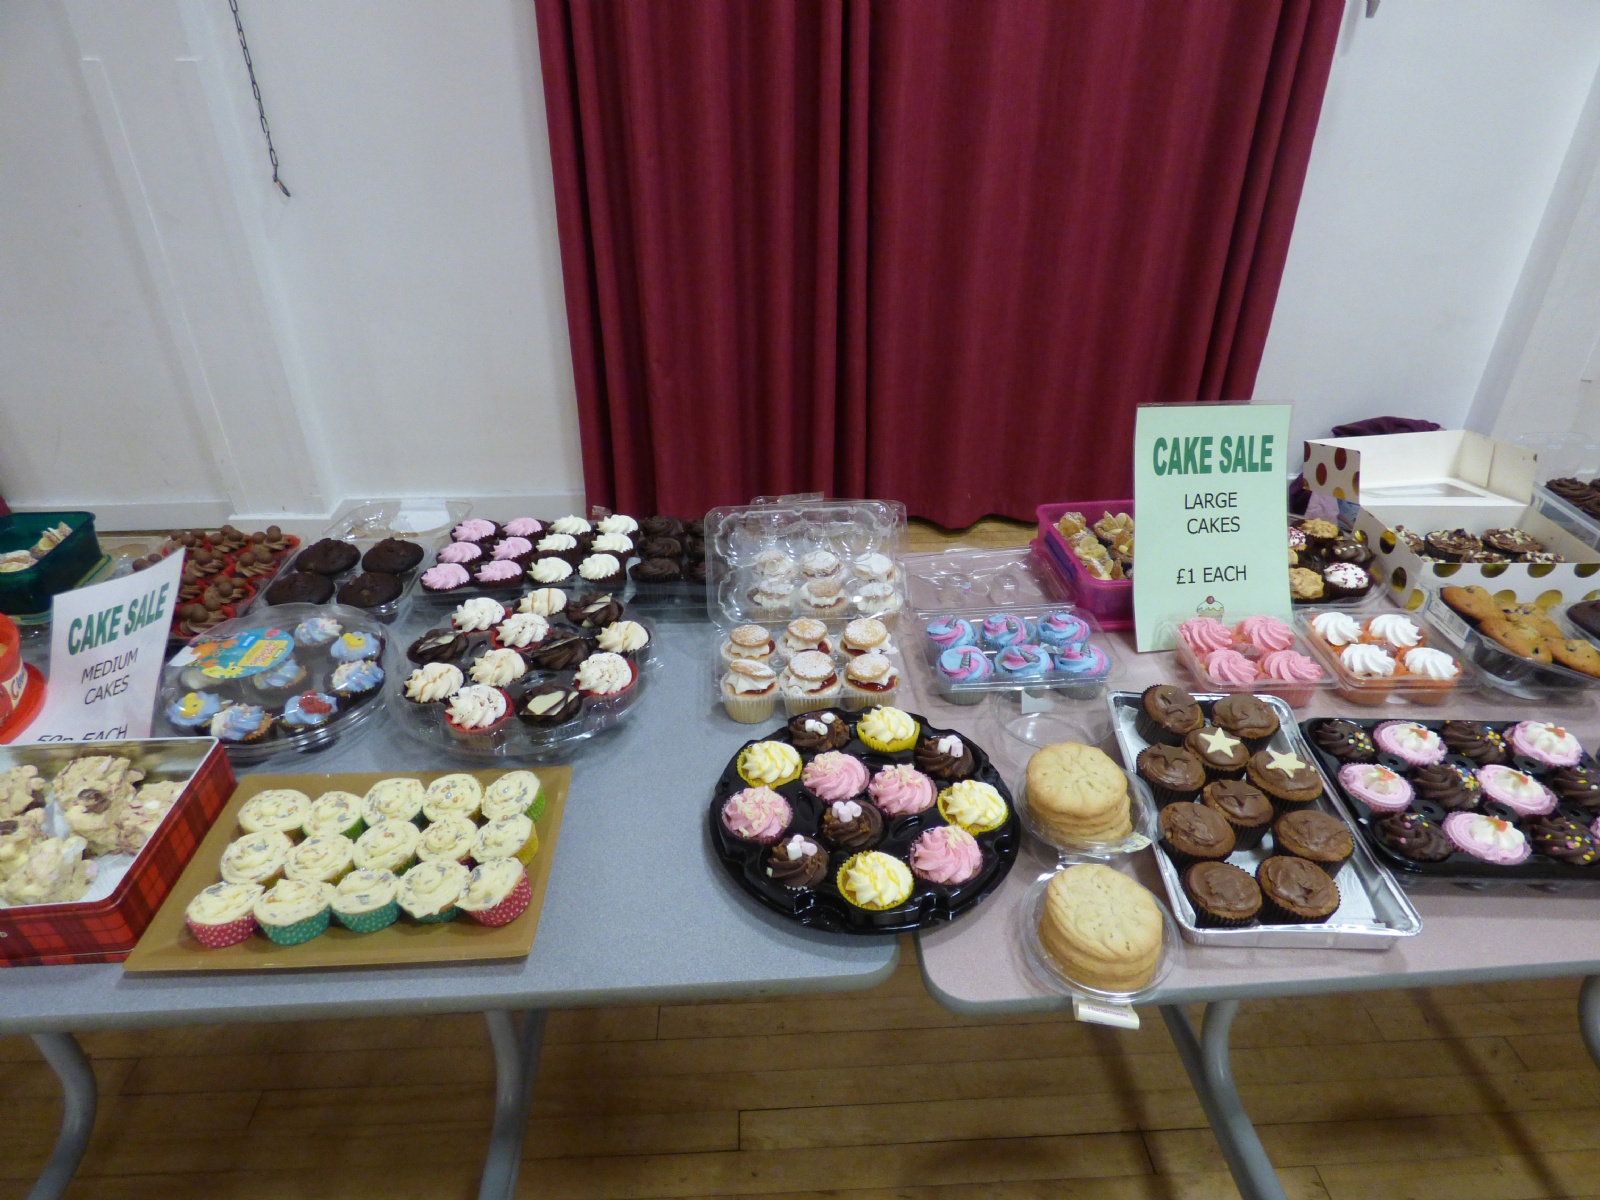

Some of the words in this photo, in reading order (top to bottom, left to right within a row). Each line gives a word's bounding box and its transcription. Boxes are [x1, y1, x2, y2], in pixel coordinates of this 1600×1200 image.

[1153, 436, 1213, 476] CAKE
[1219, 434, 1274, 474] SALE
[1184, 491, 1238, 510] LARGE
[1187, 516, 1241, 534] CAKES
[1176, 568, 1196, 585] £1
[1203, 565, 1247, 583] EACH
[68, 604, 124, 656] CAKE
[124, 582, 170, 636] SALE
[81, 648, 139, 684] MEDIUM
[84, 674, 130, 705] CAKES
